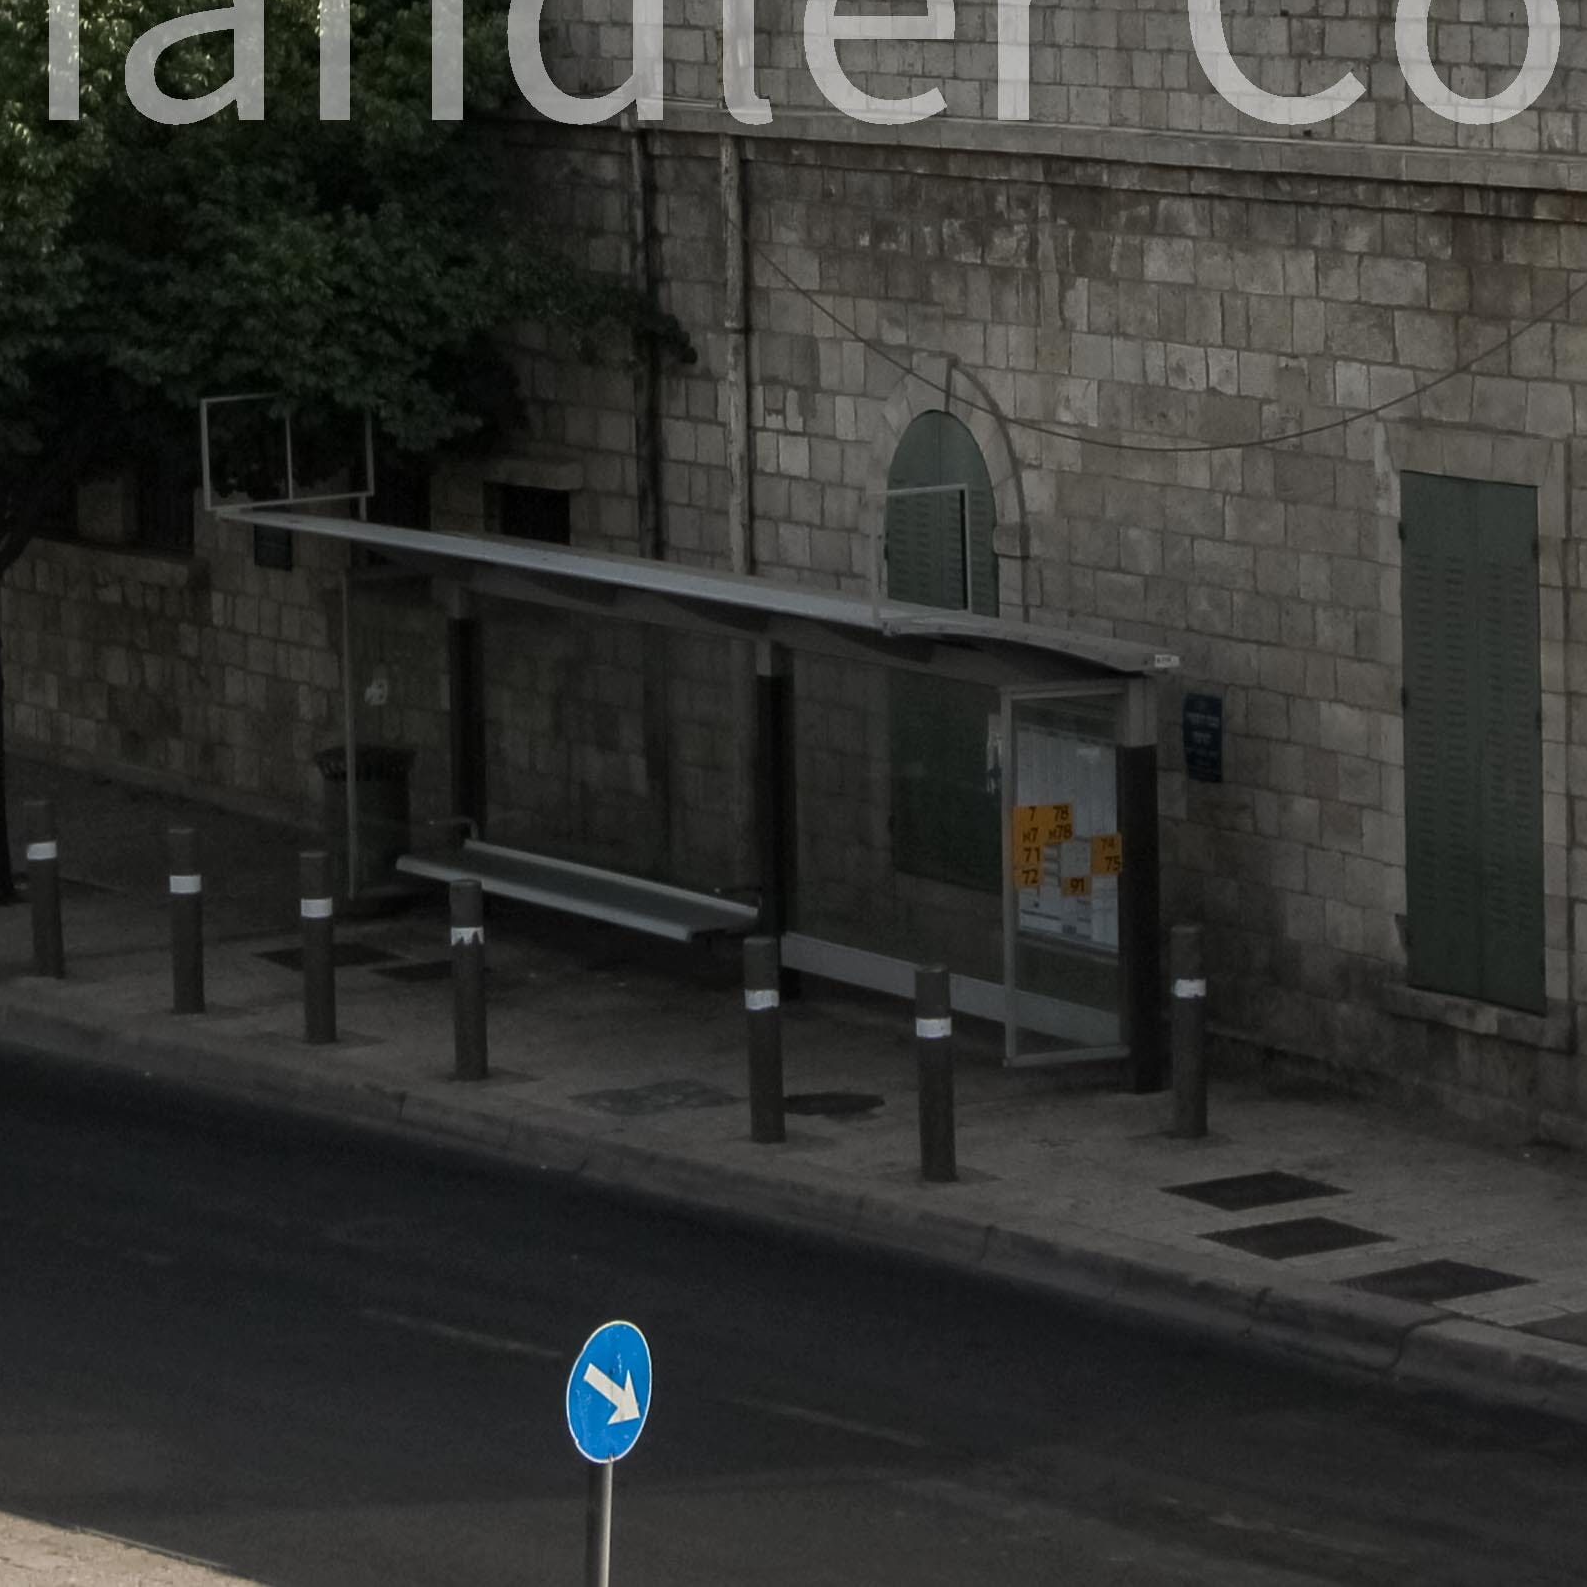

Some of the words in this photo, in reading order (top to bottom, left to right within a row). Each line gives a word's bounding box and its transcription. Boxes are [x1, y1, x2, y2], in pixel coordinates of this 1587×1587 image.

[1029, 806, 1037, 821] 7
[1053, 805, 1069, 821] 78
[1101, 837, 1115, 851] 74
[1023, 845, 1041, 861] 71
[1105, 856, 1121, 872] 75
[1022, 869, 1038, 885] 72
[1069, 877, 1085, 893] 91
